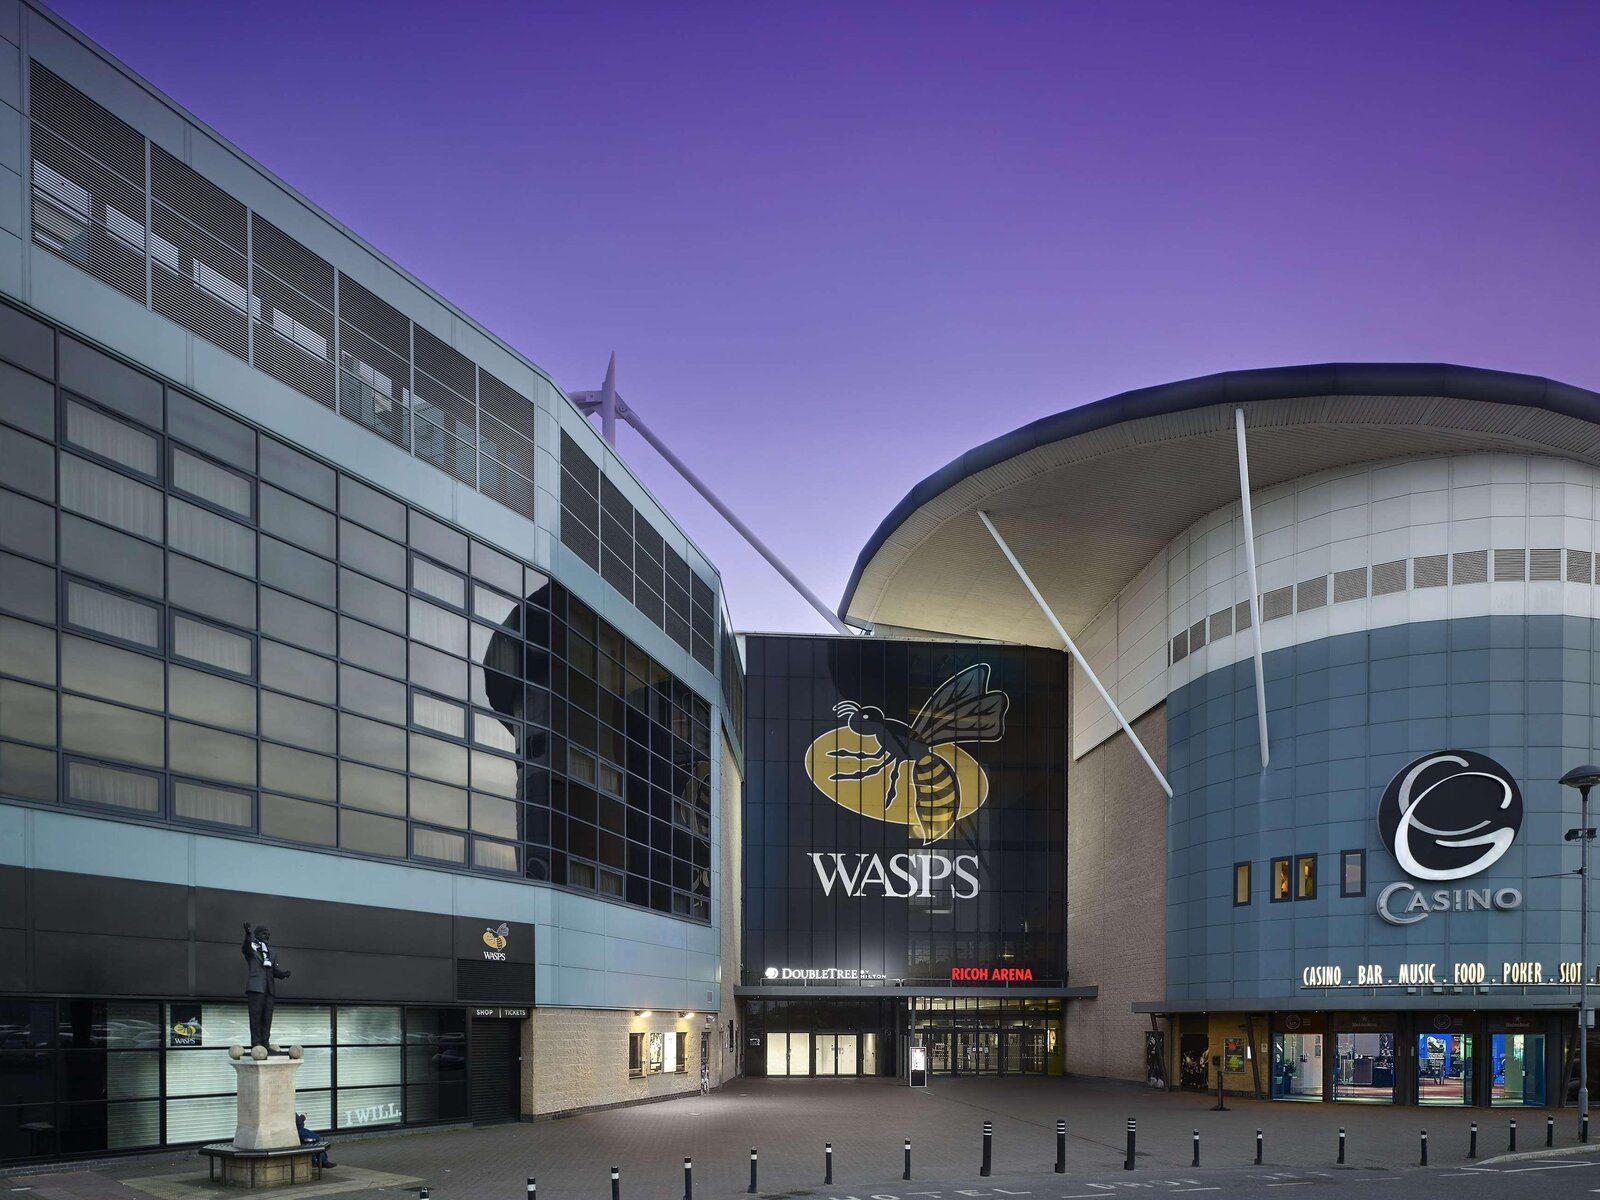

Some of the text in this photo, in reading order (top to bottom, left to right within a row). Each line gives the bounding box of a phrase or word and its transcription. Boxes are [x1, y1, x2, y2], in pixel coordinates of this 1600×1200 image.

[806, 852, 981, 899] WASPS
[1377, 882, 1522, 925] CASINO
[483, 951, 506, 961] WASPS
[951, 967, 1033, 980] RICOH ARENA
[1303, 966, 1341, 986] CASINO
[1358, 964, 1383, 985] BAR
[1399, 963, 1436, 984] MUSIC
[1454, 963, 1485, 983] FOOD
[1503, 962, 1542, 983] POKER
[345, 1111, 353, 1126] I
